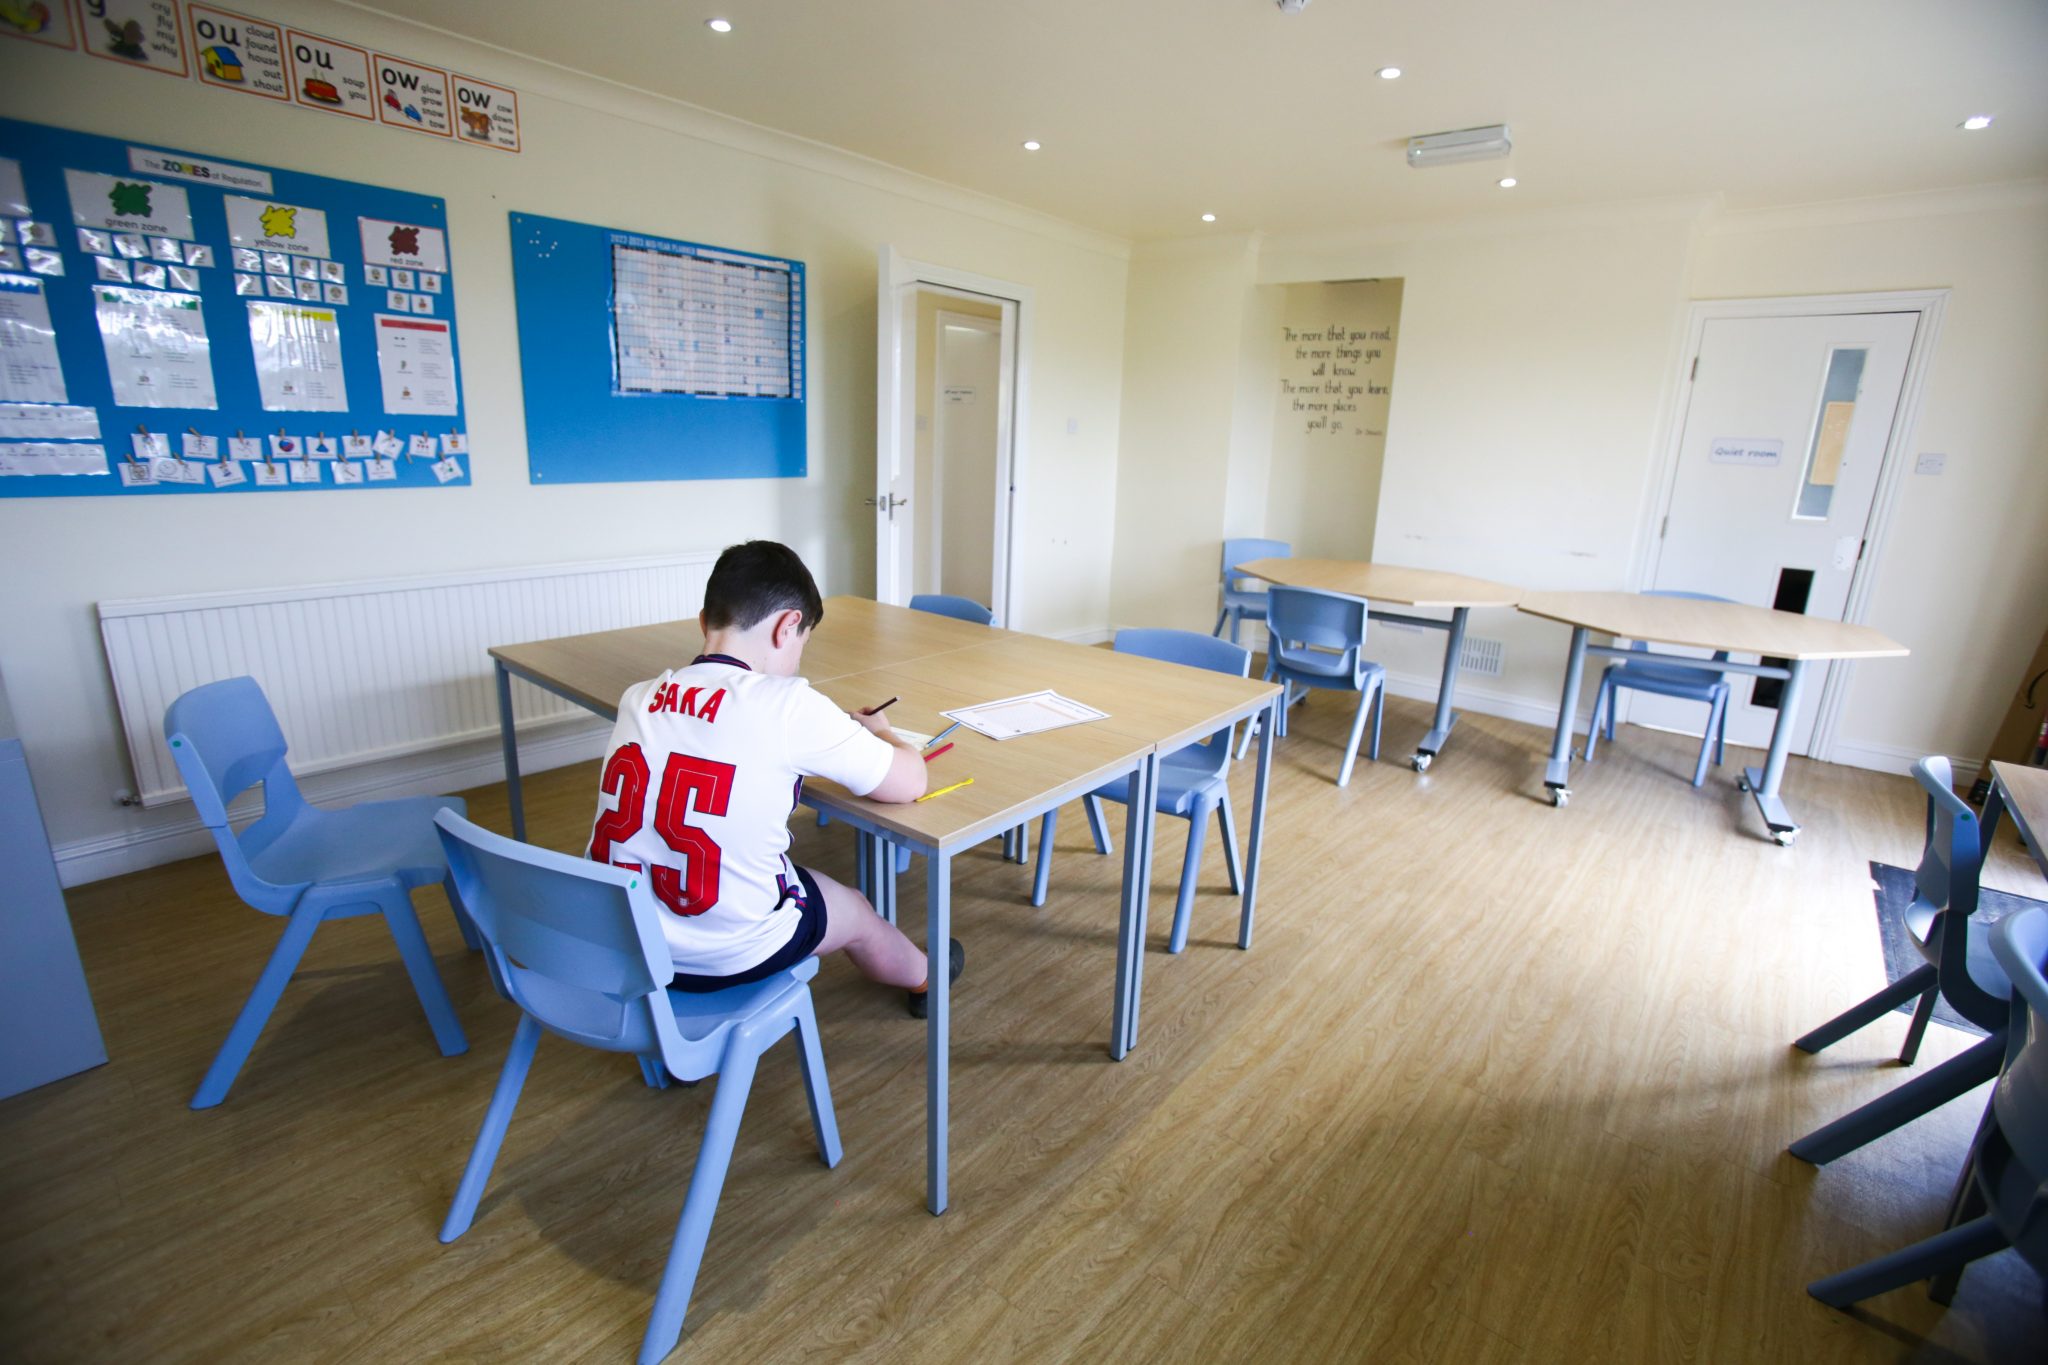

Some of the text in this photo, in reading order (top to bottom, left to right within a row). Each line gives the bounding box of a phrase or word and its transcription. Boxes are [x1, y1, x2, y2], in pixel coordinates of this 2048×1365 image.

[152, 2, 171, 16] cry
[158, 15, 173, 31] fly
[157, 31, 175, 44] my
[197, 20, 240, 47] ou
[246, 26, 275, 40] cloud
[152, 42, 178, 58] why
[246, 39, 278, 53] found
[248, 52, 279, 66] house
[296, 45, 334, 70] ou
[263, 69, 282, 79] out
[382, 68, 419, 91] ow
[253, 80, 283, 93] shout
[343, 77, 365, 89] soup
[348, 90, 367, 101] you
[458, 88, 491, 109] ow
[106, 218, 168, 234] green zone
[254, 237, 309, 252] yellow zone
[390, 257, 424, 267] red zone
[1282, 327, 1298, 341] The
[1302, 332, 1322, 341] more
[1327, 325, 1345, 341] that
[1349, 332, 1366, 345] you
[1296, 345, 1381, 364] the more things you
[1312, 363, 1356, 376] will know
[1281, 380, 1296, 394] The
[1300, 385, 1320, 394] more
[1325, 380, 1343, 394] that
[1347, 386, 1363, 400] you
[1292, 399, 1357, 415] the more places
[1715, 447, 1777, 458] Quiet room
[648, 682, 727, 724] SAKA
[590, 742, 737, 917] 25
